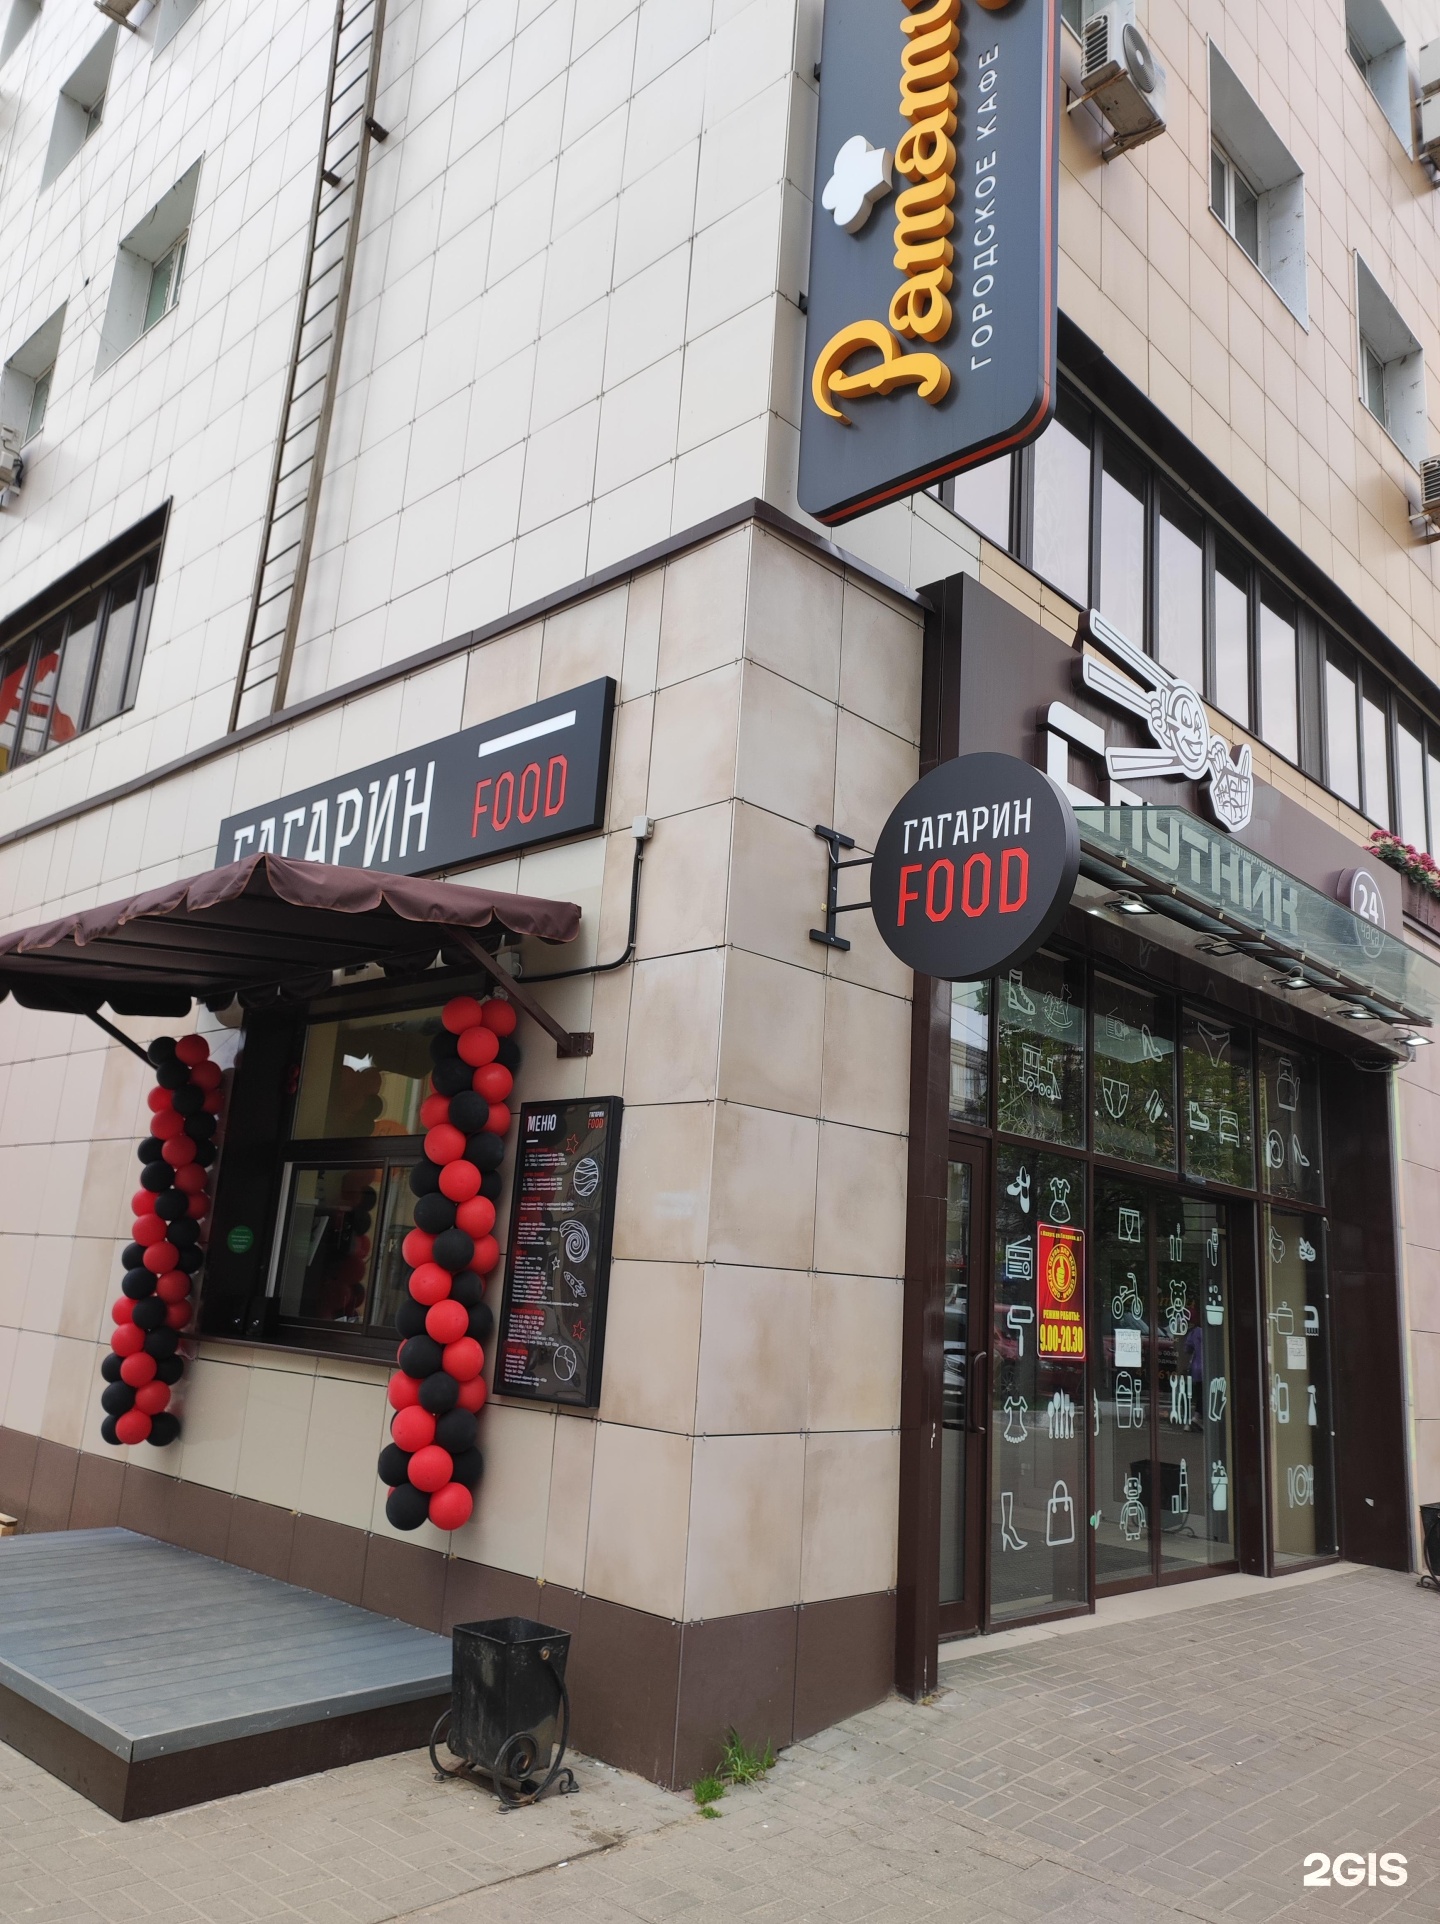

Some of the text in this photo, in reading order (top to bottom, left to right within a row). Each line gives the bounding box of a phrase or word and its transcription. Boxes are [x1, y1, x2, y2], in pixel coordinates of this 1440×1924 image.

[971, 43, 999, 371] ГОРОДСКОЕ КАФЕ
[471, 754, 569, 839] FOOD
[902, 797, 1033, 855] ГАГАРИН
[896, 846, 1030, 927] FOOD
[1358, 884, 1379, 924] 24
[527, 1114, 557, 1132] МЕНЮ
[587, 1118, 604, 1129] FOOD
[1039, 1323, 1083, 1353] 9.00-20.30
